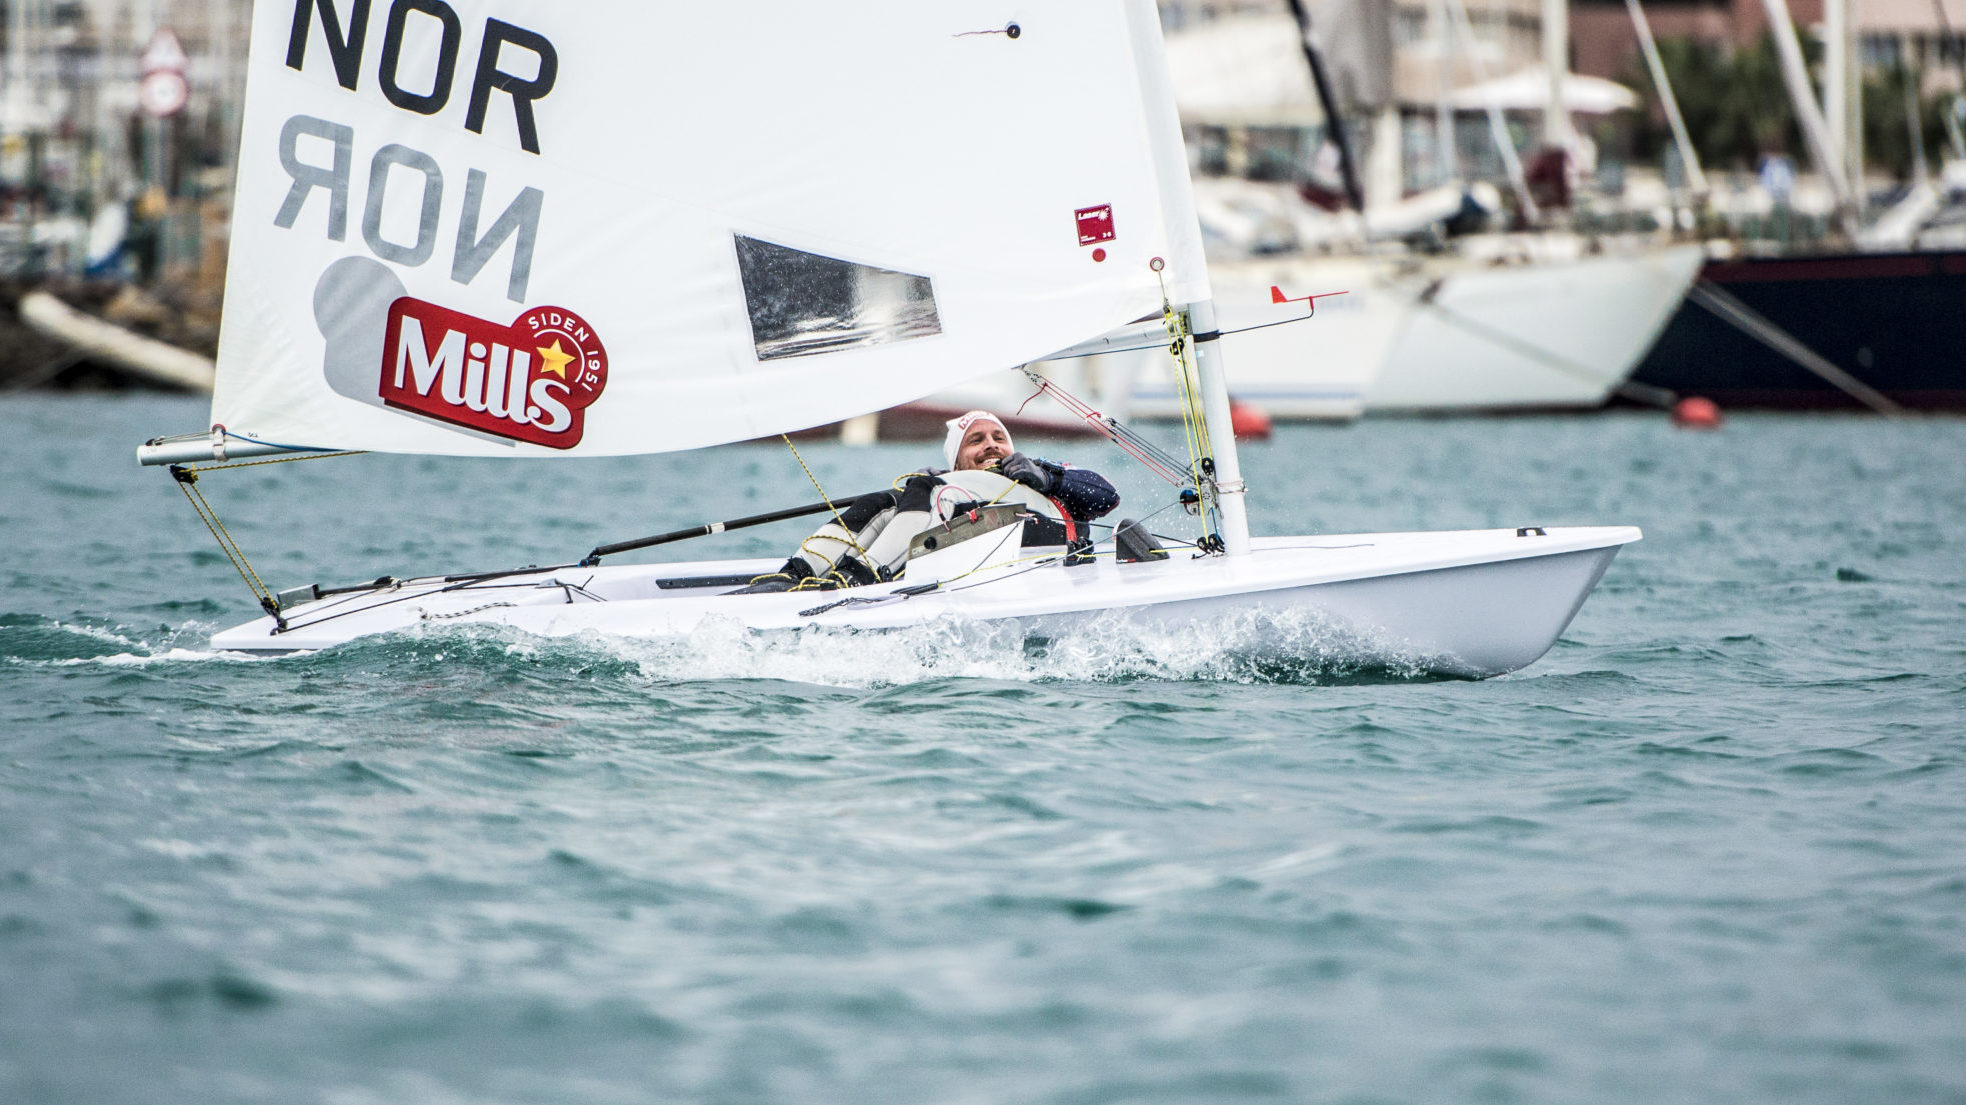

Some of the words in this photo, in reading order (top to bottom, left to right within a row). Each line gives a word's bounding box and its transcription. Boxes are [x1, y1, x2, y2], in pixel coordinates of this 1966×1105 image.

[286, 0, 558, 155] NOR
[394, 314, 572, 433] Mills
[528, 312, 590, 343] SIDEN
[581, 350, 601, 392] 1951
